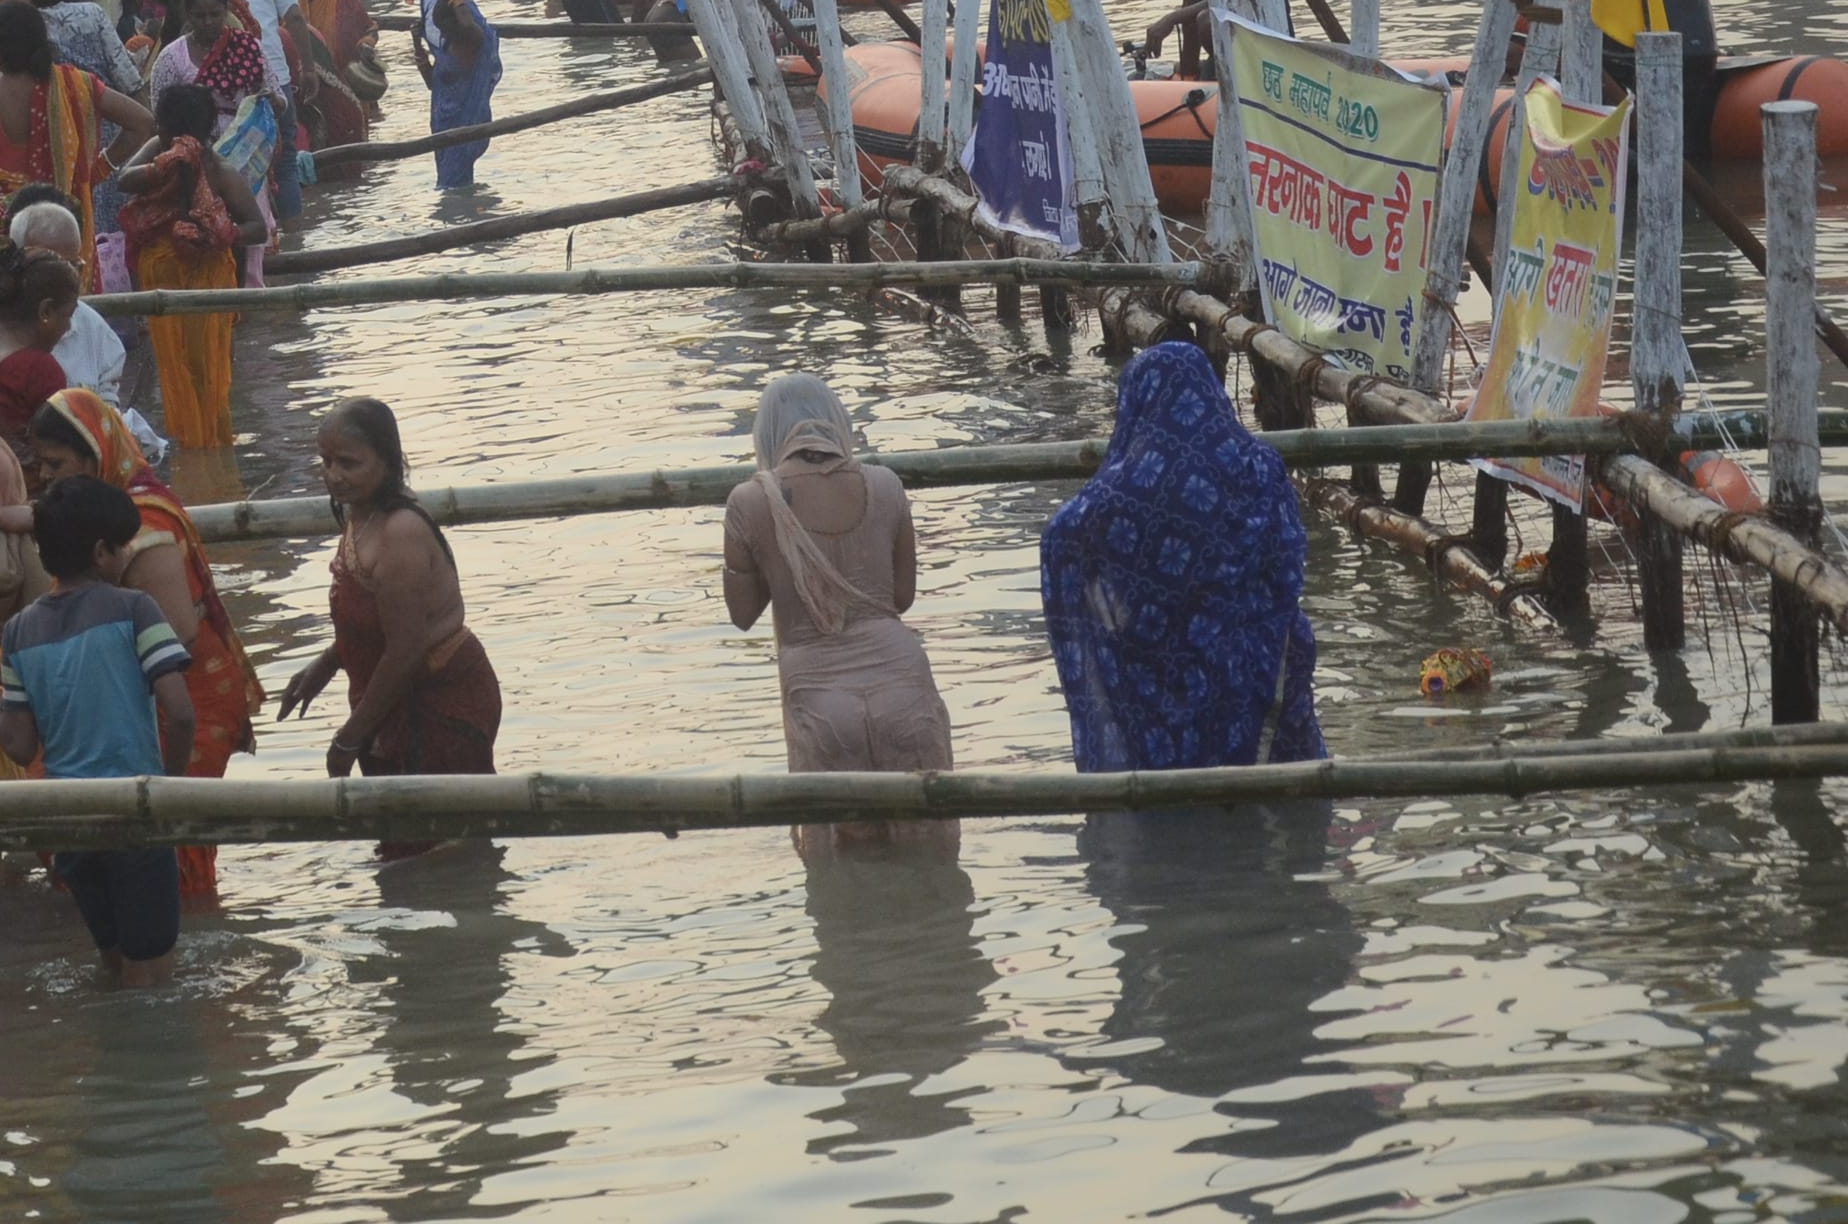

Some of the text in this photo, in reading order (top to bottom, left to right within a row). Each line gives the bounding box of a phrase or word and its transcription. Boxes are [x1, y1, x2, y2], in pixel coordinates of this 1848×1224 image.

[1262, 60, 1379, 143] छठ महापर्व 2020
[1245, 139, 1325, 231] तरनाक
[1327, 179, 1375, 257] घाट
[1263, 257, 1298, 306] आगे
[1293, 276, 1336, 324] जाना
[1506, 238, 1545, 304] आगे
